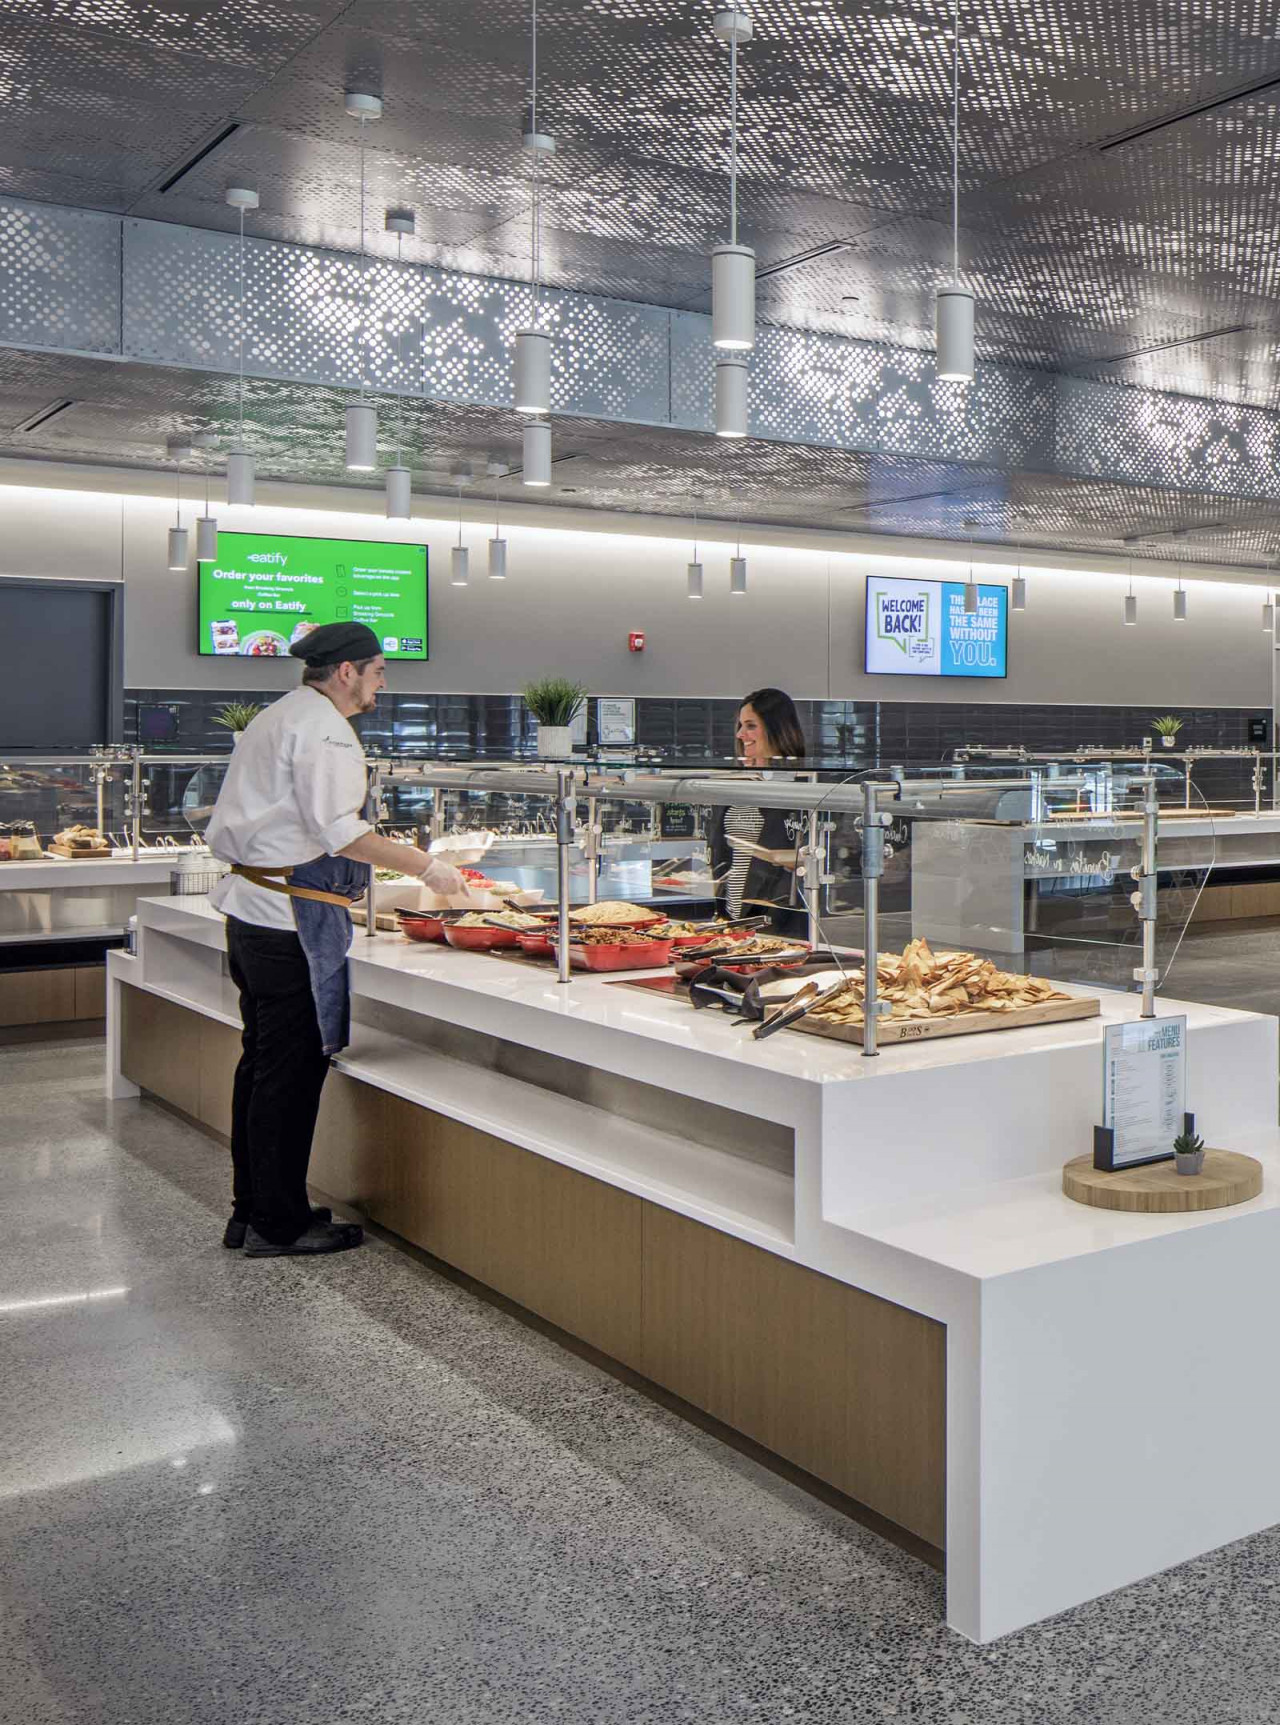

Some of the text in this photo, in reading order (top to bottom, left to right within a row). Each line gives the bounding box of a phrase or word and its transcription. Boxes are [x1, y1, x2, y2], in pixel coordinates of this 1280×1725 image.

[248, 552, 288, 566] eatify
[213, 569, 324, 583] Order your favorites
[231, 599, 306, 612] only on Eatify
[882, 599, 924, 612] WELCOME
[977, 597, 998, 607] LACE
[884, 614, 922, 633] BACK!
[950, 615, 998, 629] THE SAME
[950, 627, 998, 641] WITHOUT
[950, 641, 997, 666] YOU.
[1161, 1024, 1180, 1037] MENU
[1148, 1037, 1180, 1051] FEATURES
